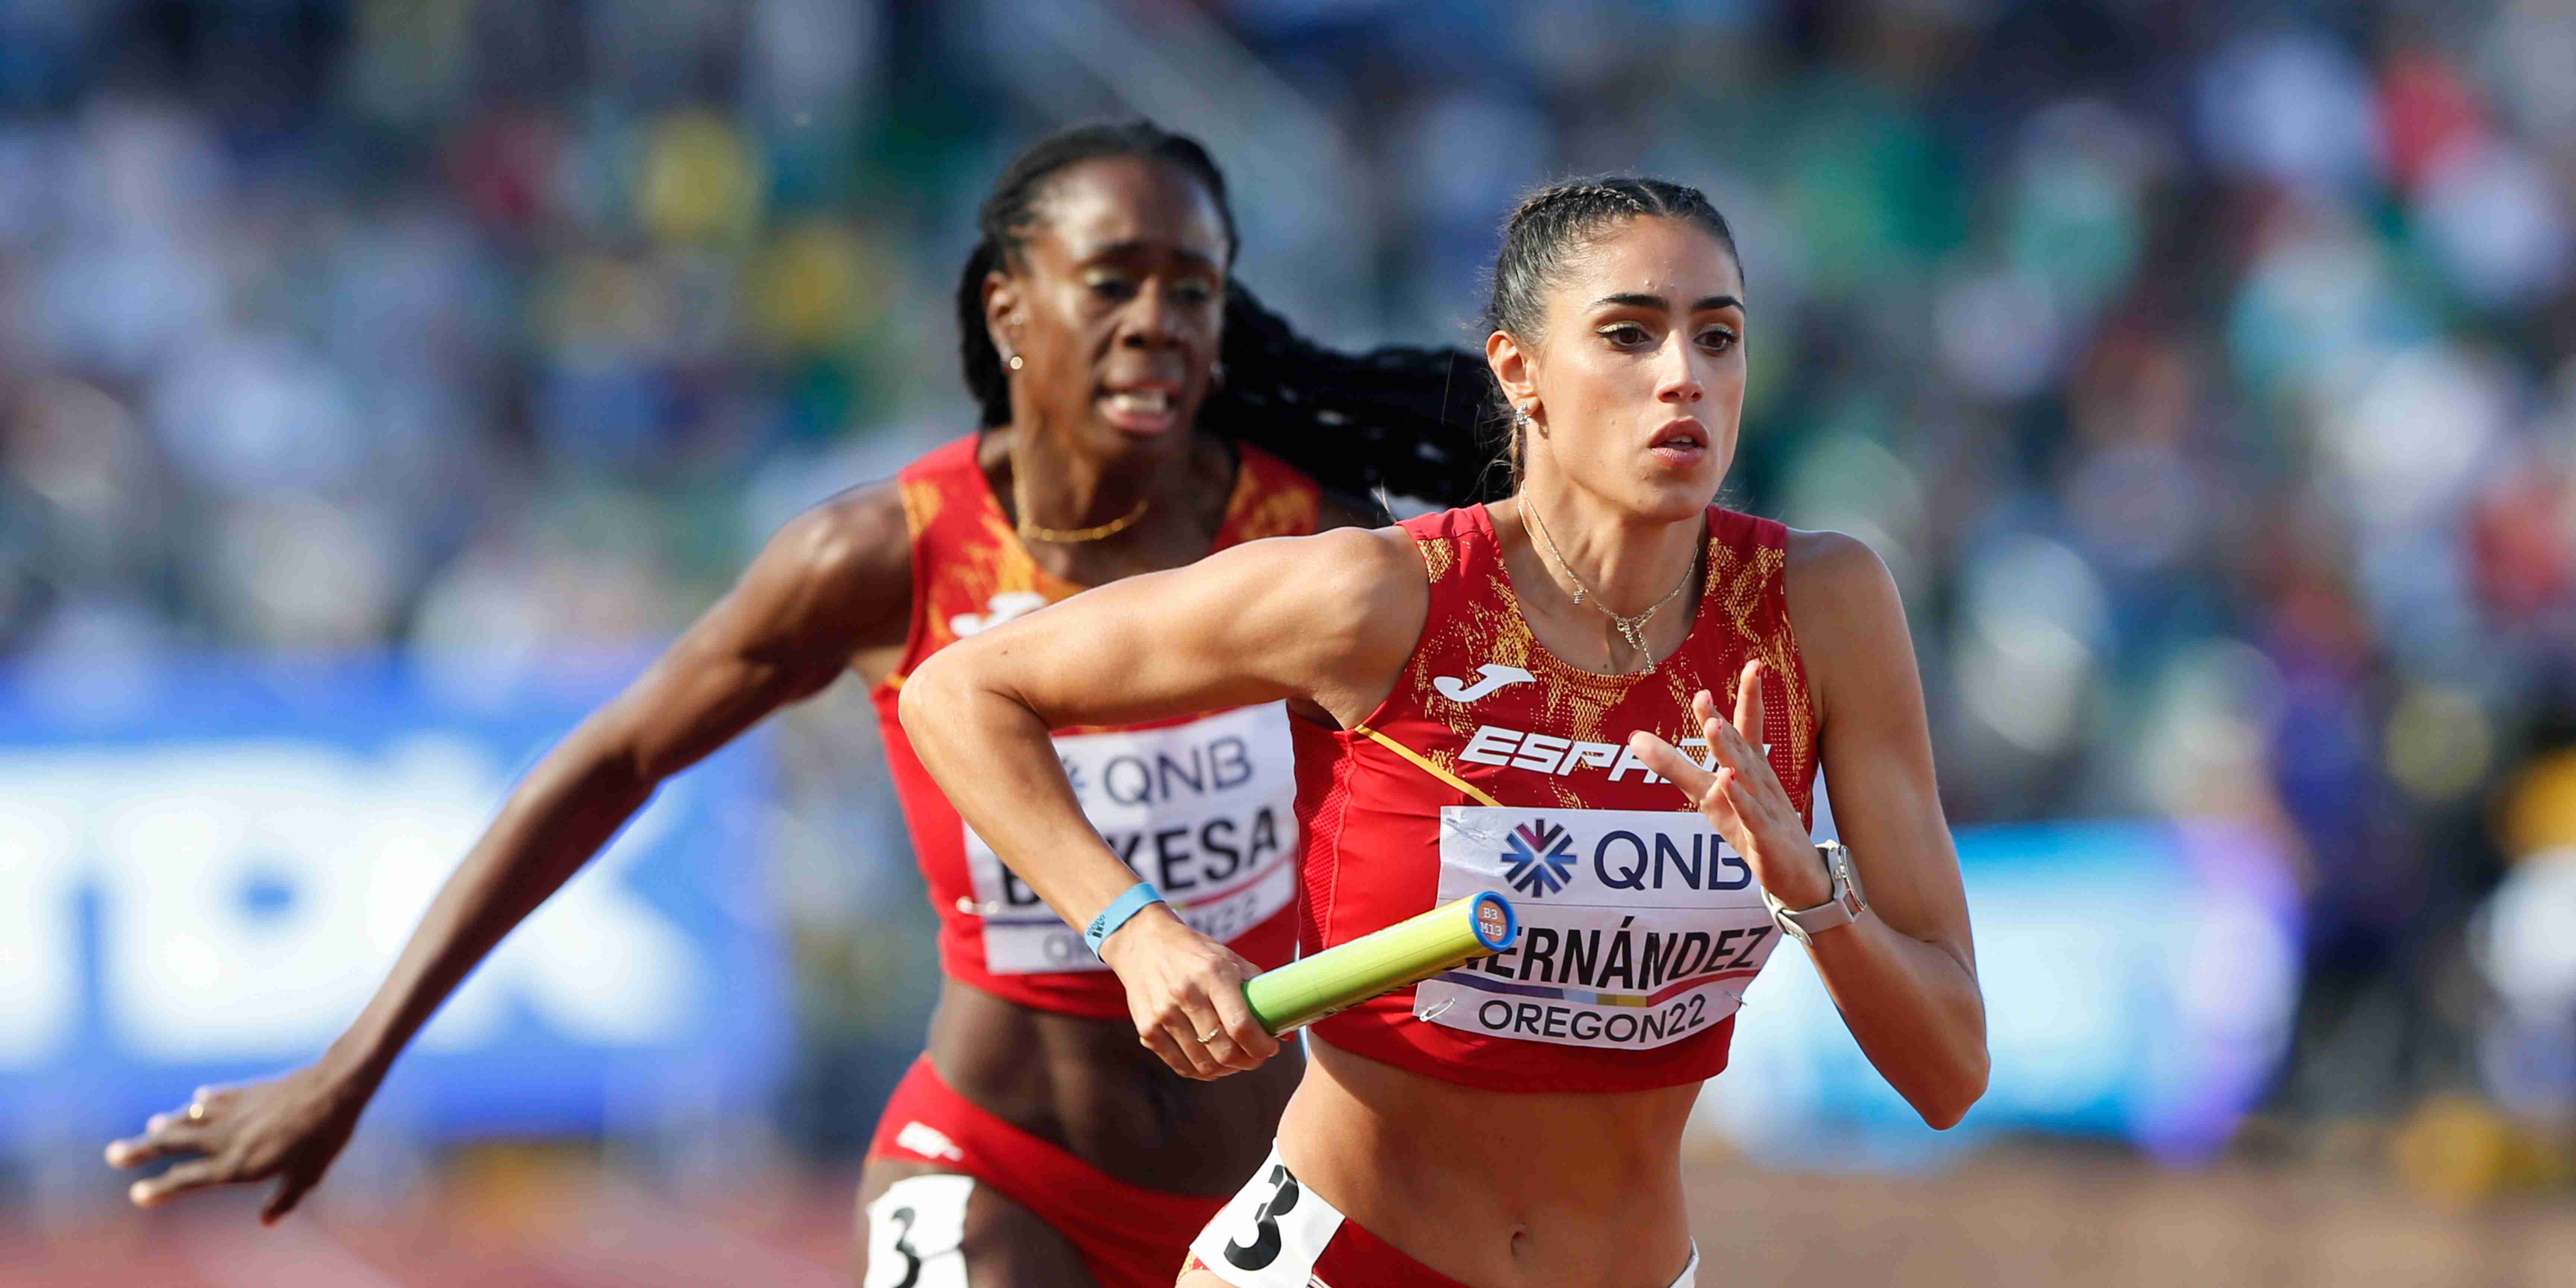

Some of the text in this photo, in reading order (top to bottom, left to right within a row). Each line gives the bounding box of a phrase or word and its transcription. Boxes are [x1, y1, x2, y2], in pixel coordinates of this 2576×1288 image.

[1103, 736, 1254, 806] QNB
[1458, 724, 1772, 784] ESPA
[1001, 805, 1276, 907] BKESA
[1594, 830, 1752, 890] QNB
[1480, 921, 1502, 936] M13
[1483, 907, 1497, 919] B3
[1444, 916, 1774, 990] ERNÁNDEZ
[1479, 994, 1705, 1043] OREGON22
[1224, 1164, 1300, 1271] 3
